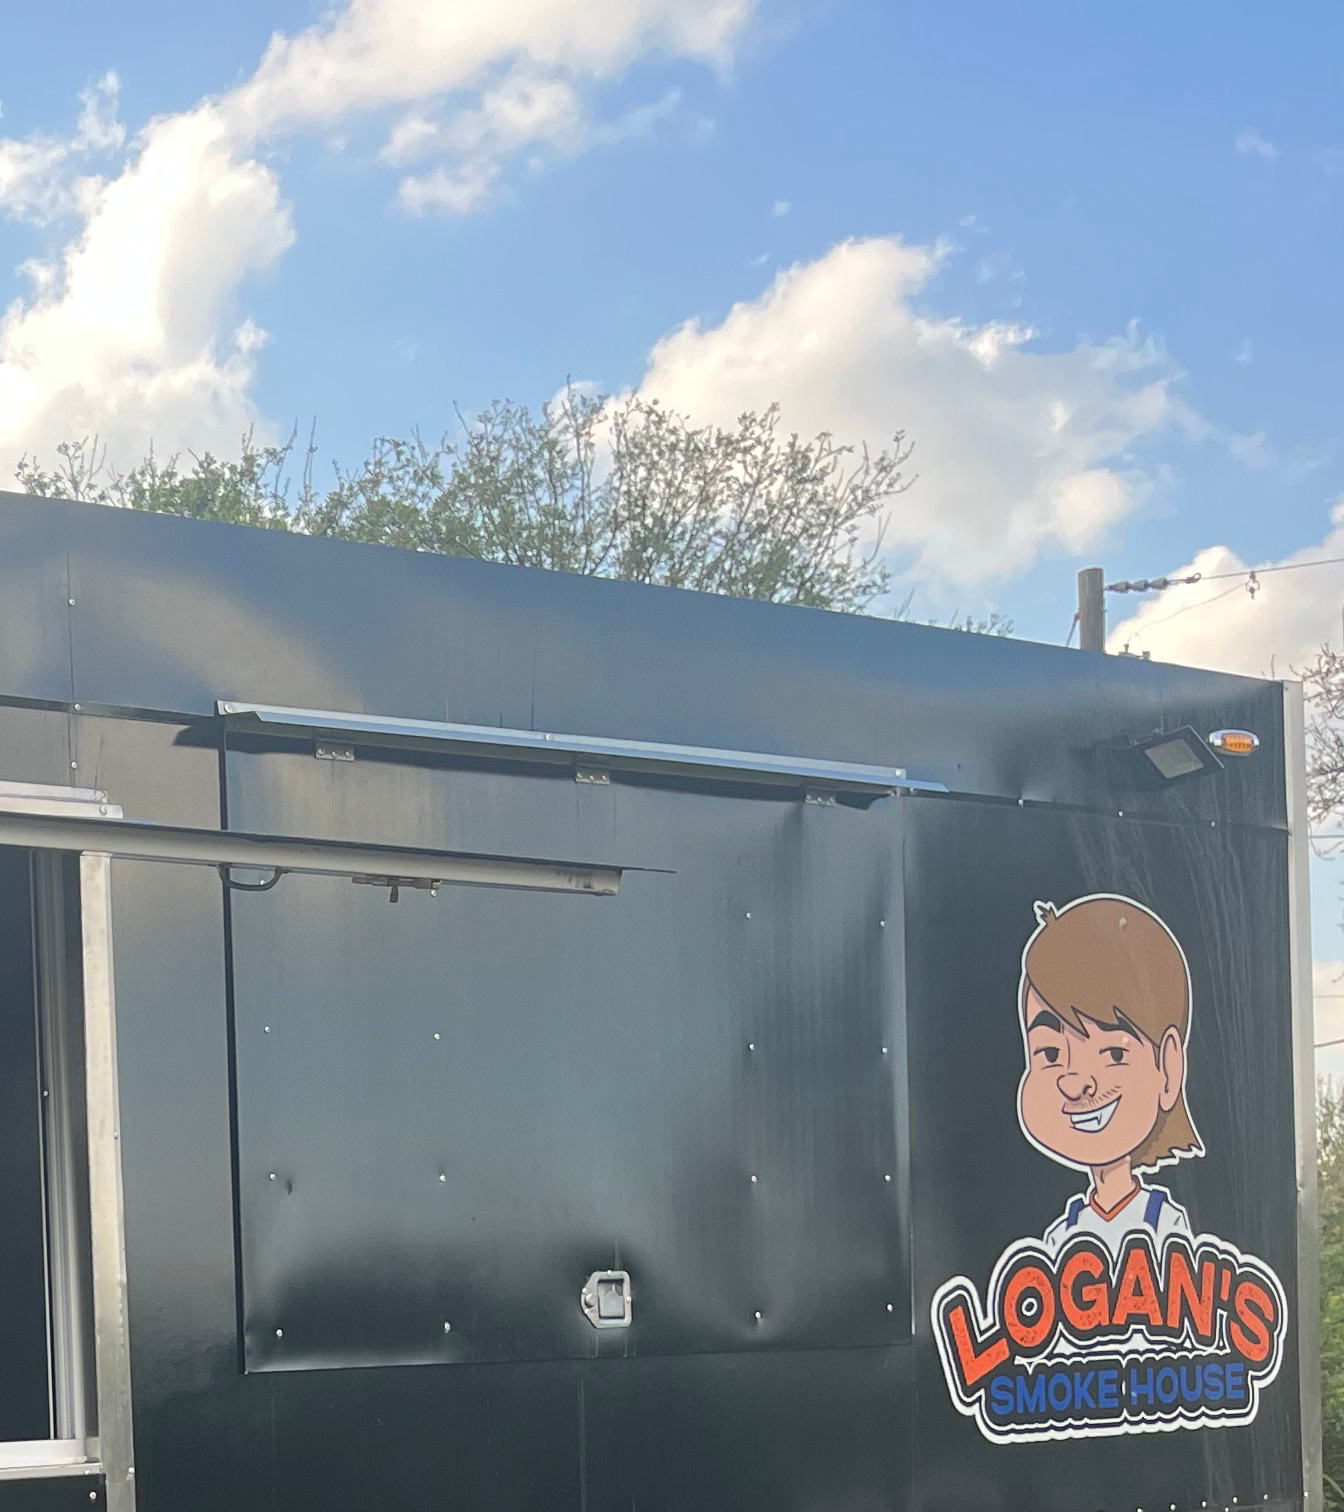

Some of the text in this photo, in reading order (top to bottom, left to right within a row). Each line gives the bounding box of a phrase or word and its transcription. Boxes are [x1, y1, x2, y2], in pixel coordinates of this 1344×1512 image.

[948, 1248, 1274, 1385] LOGAN'S
[991, 1362, 1245, 1416] SMOKE HOUSE
